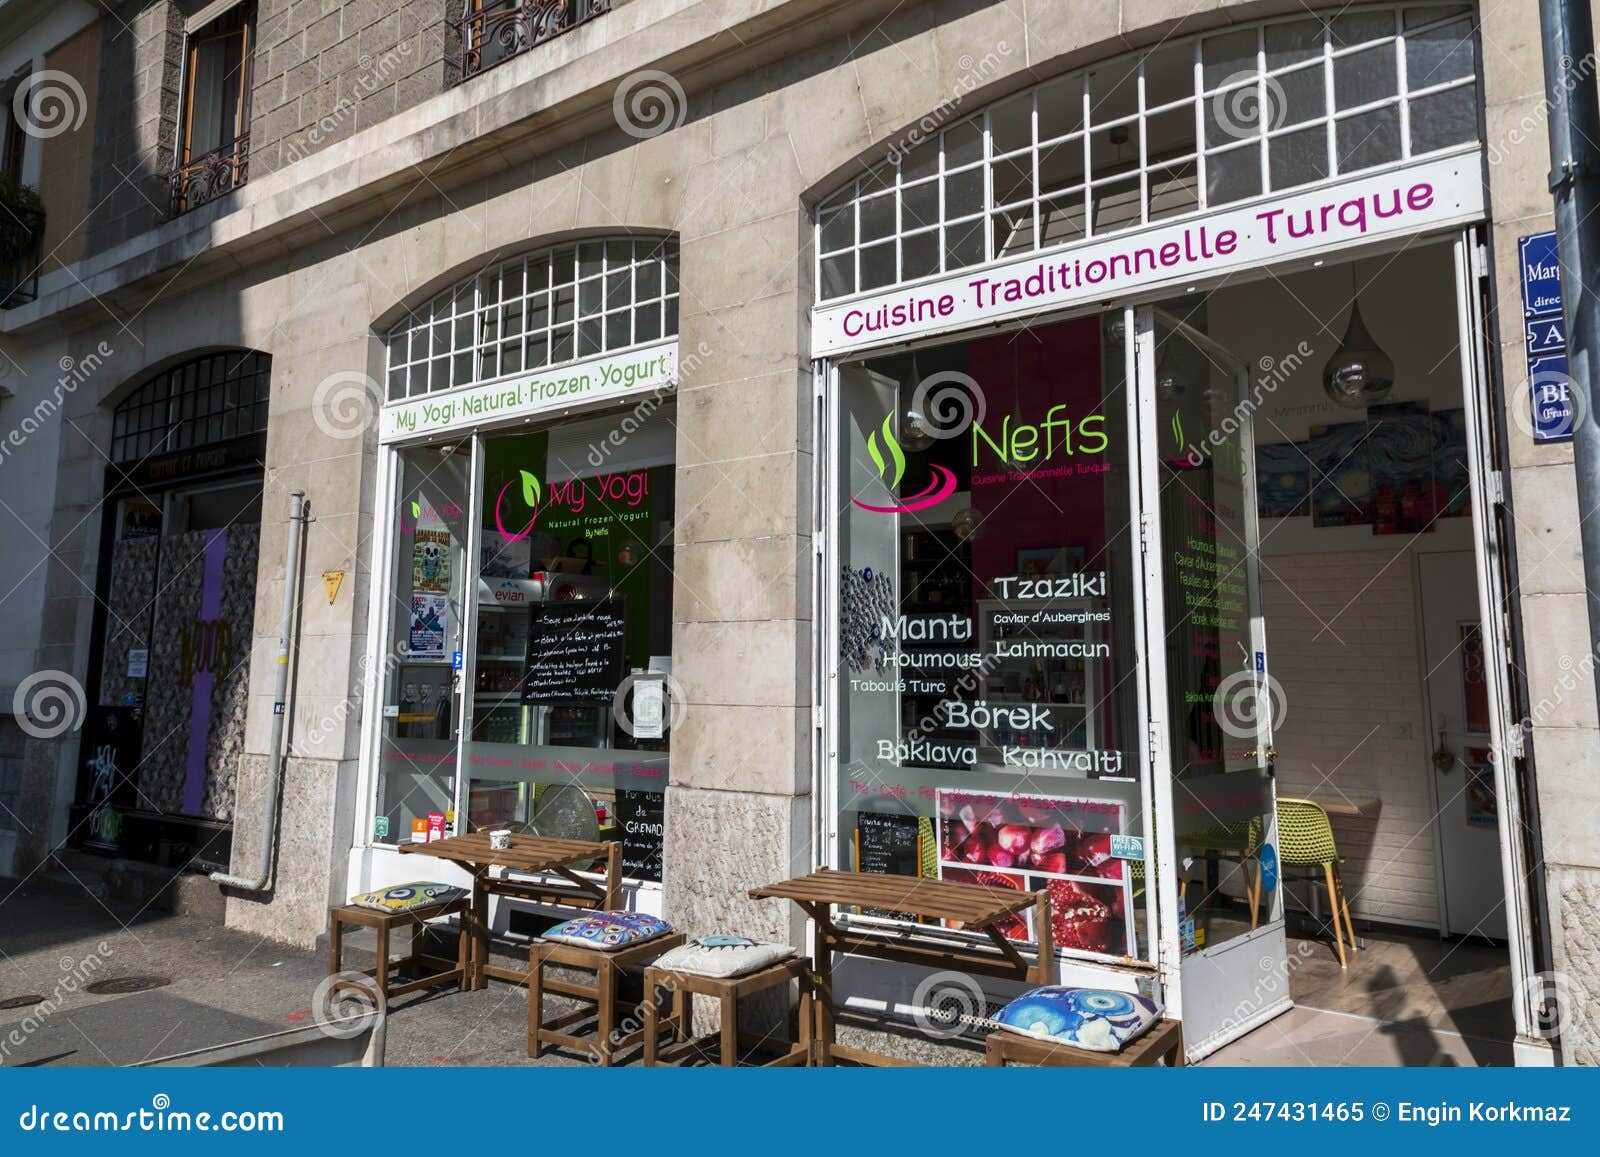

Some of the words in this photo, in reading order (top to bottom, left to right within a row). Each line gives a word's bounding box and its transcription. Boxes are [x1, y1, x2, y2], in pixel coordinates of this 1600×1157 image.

[842, 292, 956, 338] Cuisine
[969, 229, 1238, 309] Traditionnelle
[1256, 182, 1435, 243] Turque
[396, 409, 416, 432] My
[422, 402, 456, 425] Yogi
[462, 384, 523, 417] Natural
[530, 374, 591, 402] Frozen
[600, 354, 667, 388] Yogurt
[972, 403, 1109, 468] Nefis
[549, 478, 585, 513] My
[595, 466, 649, 506] Yogi
[548, 517, 581, 529] Natural
[618, 511, 649, 522] Yogurt
[585, 529, 595, 539] By
[993, 571, 1107, 600] Tzaziki
[495, 589, 525, 602] evian
[993, 613, 1030, 625] Caviar
[1031, 611, 1111, 625] d'Aubergines
[994, 641, 1111, 658] Lahmacun
[882, 650, 983, 668] Houmous
[850, 679, 906, 693] Taboulé
[909, 680, 946, 694] Turc
[945, 700, 1054, 731] Börek
[876, 739, 978, 765] Baklava
[625, 820, 664, 837] GRENAD
